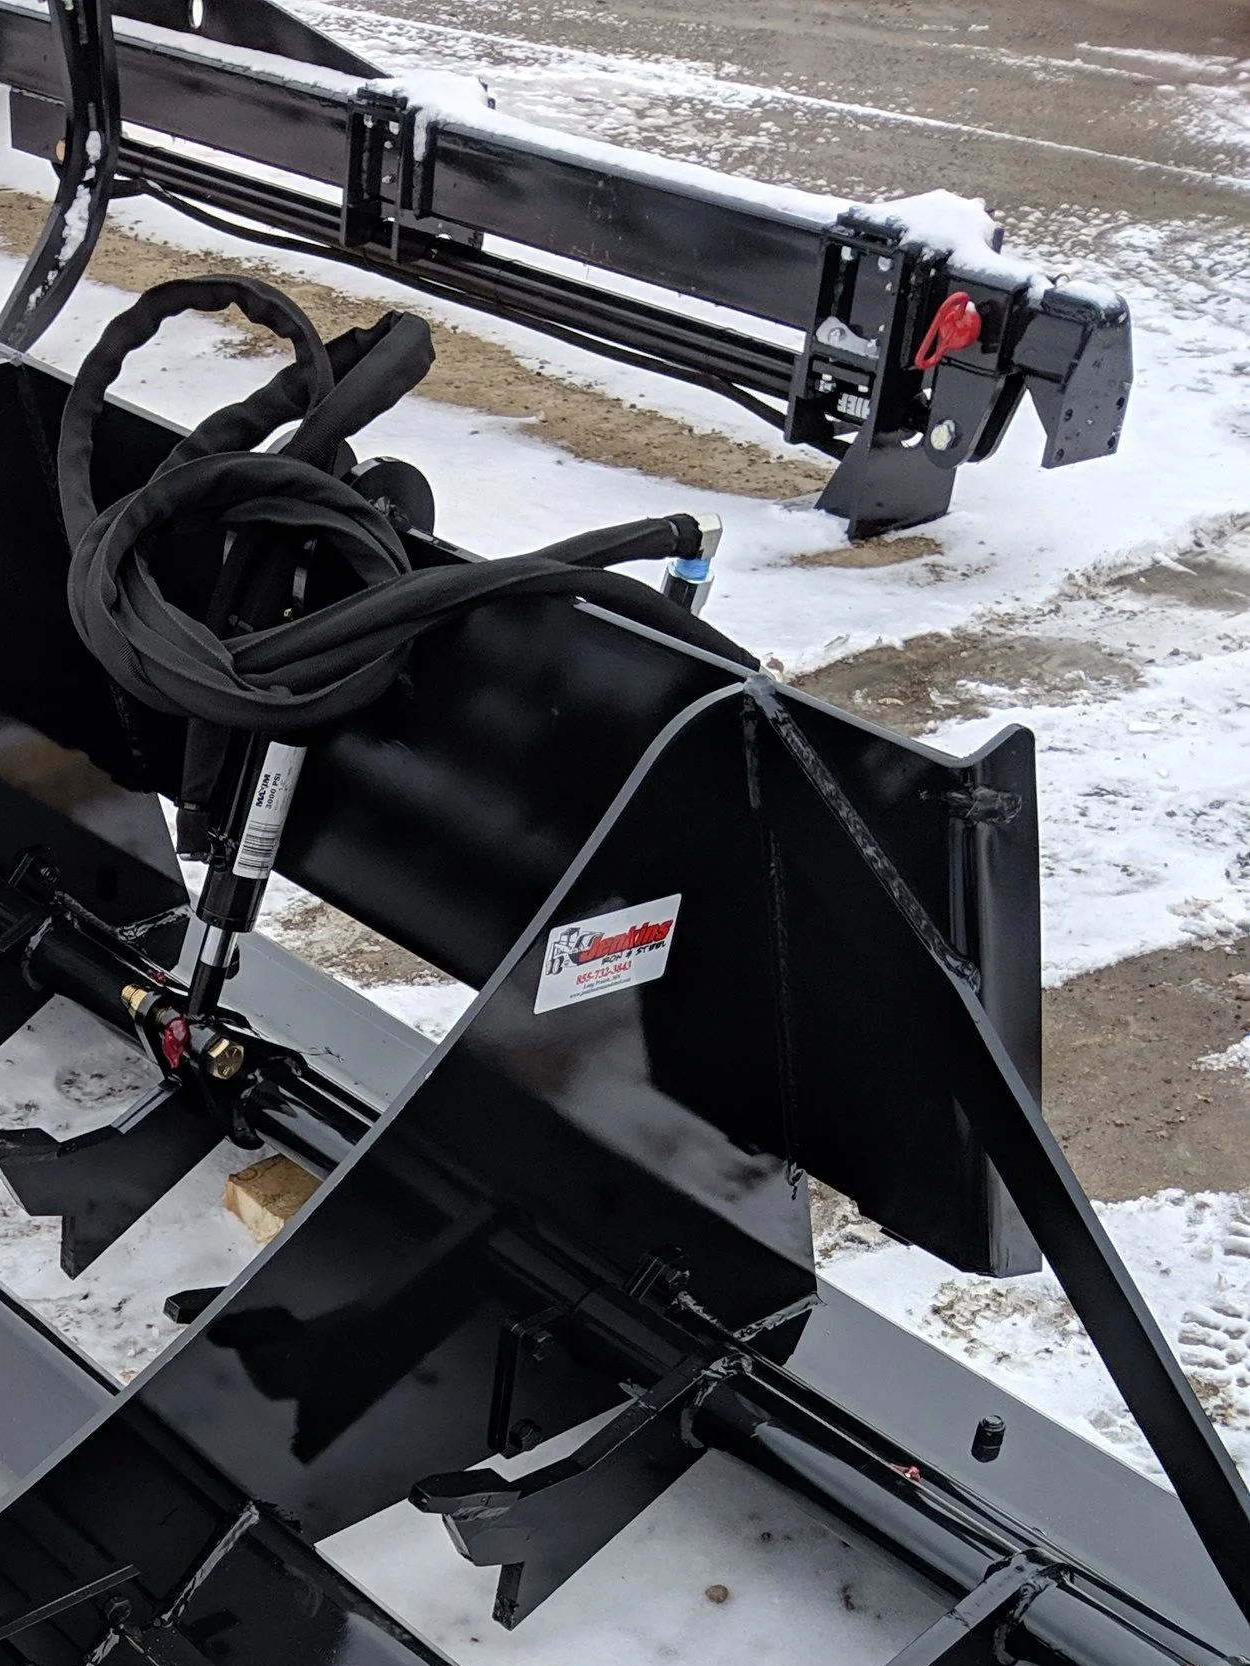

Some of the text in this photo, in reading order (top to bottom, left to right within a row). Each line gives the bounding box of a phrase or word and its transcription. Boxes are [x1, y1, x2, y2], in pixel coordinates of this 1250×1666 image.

[255, 773, 271, 807] MAXIM
[265, 773, 281, 810] 3000 PSI
[577, 919, 673, 964] Jenkins
[601, 952, 623, 965] IRON
[635, 940, 666, 955] STEEL
